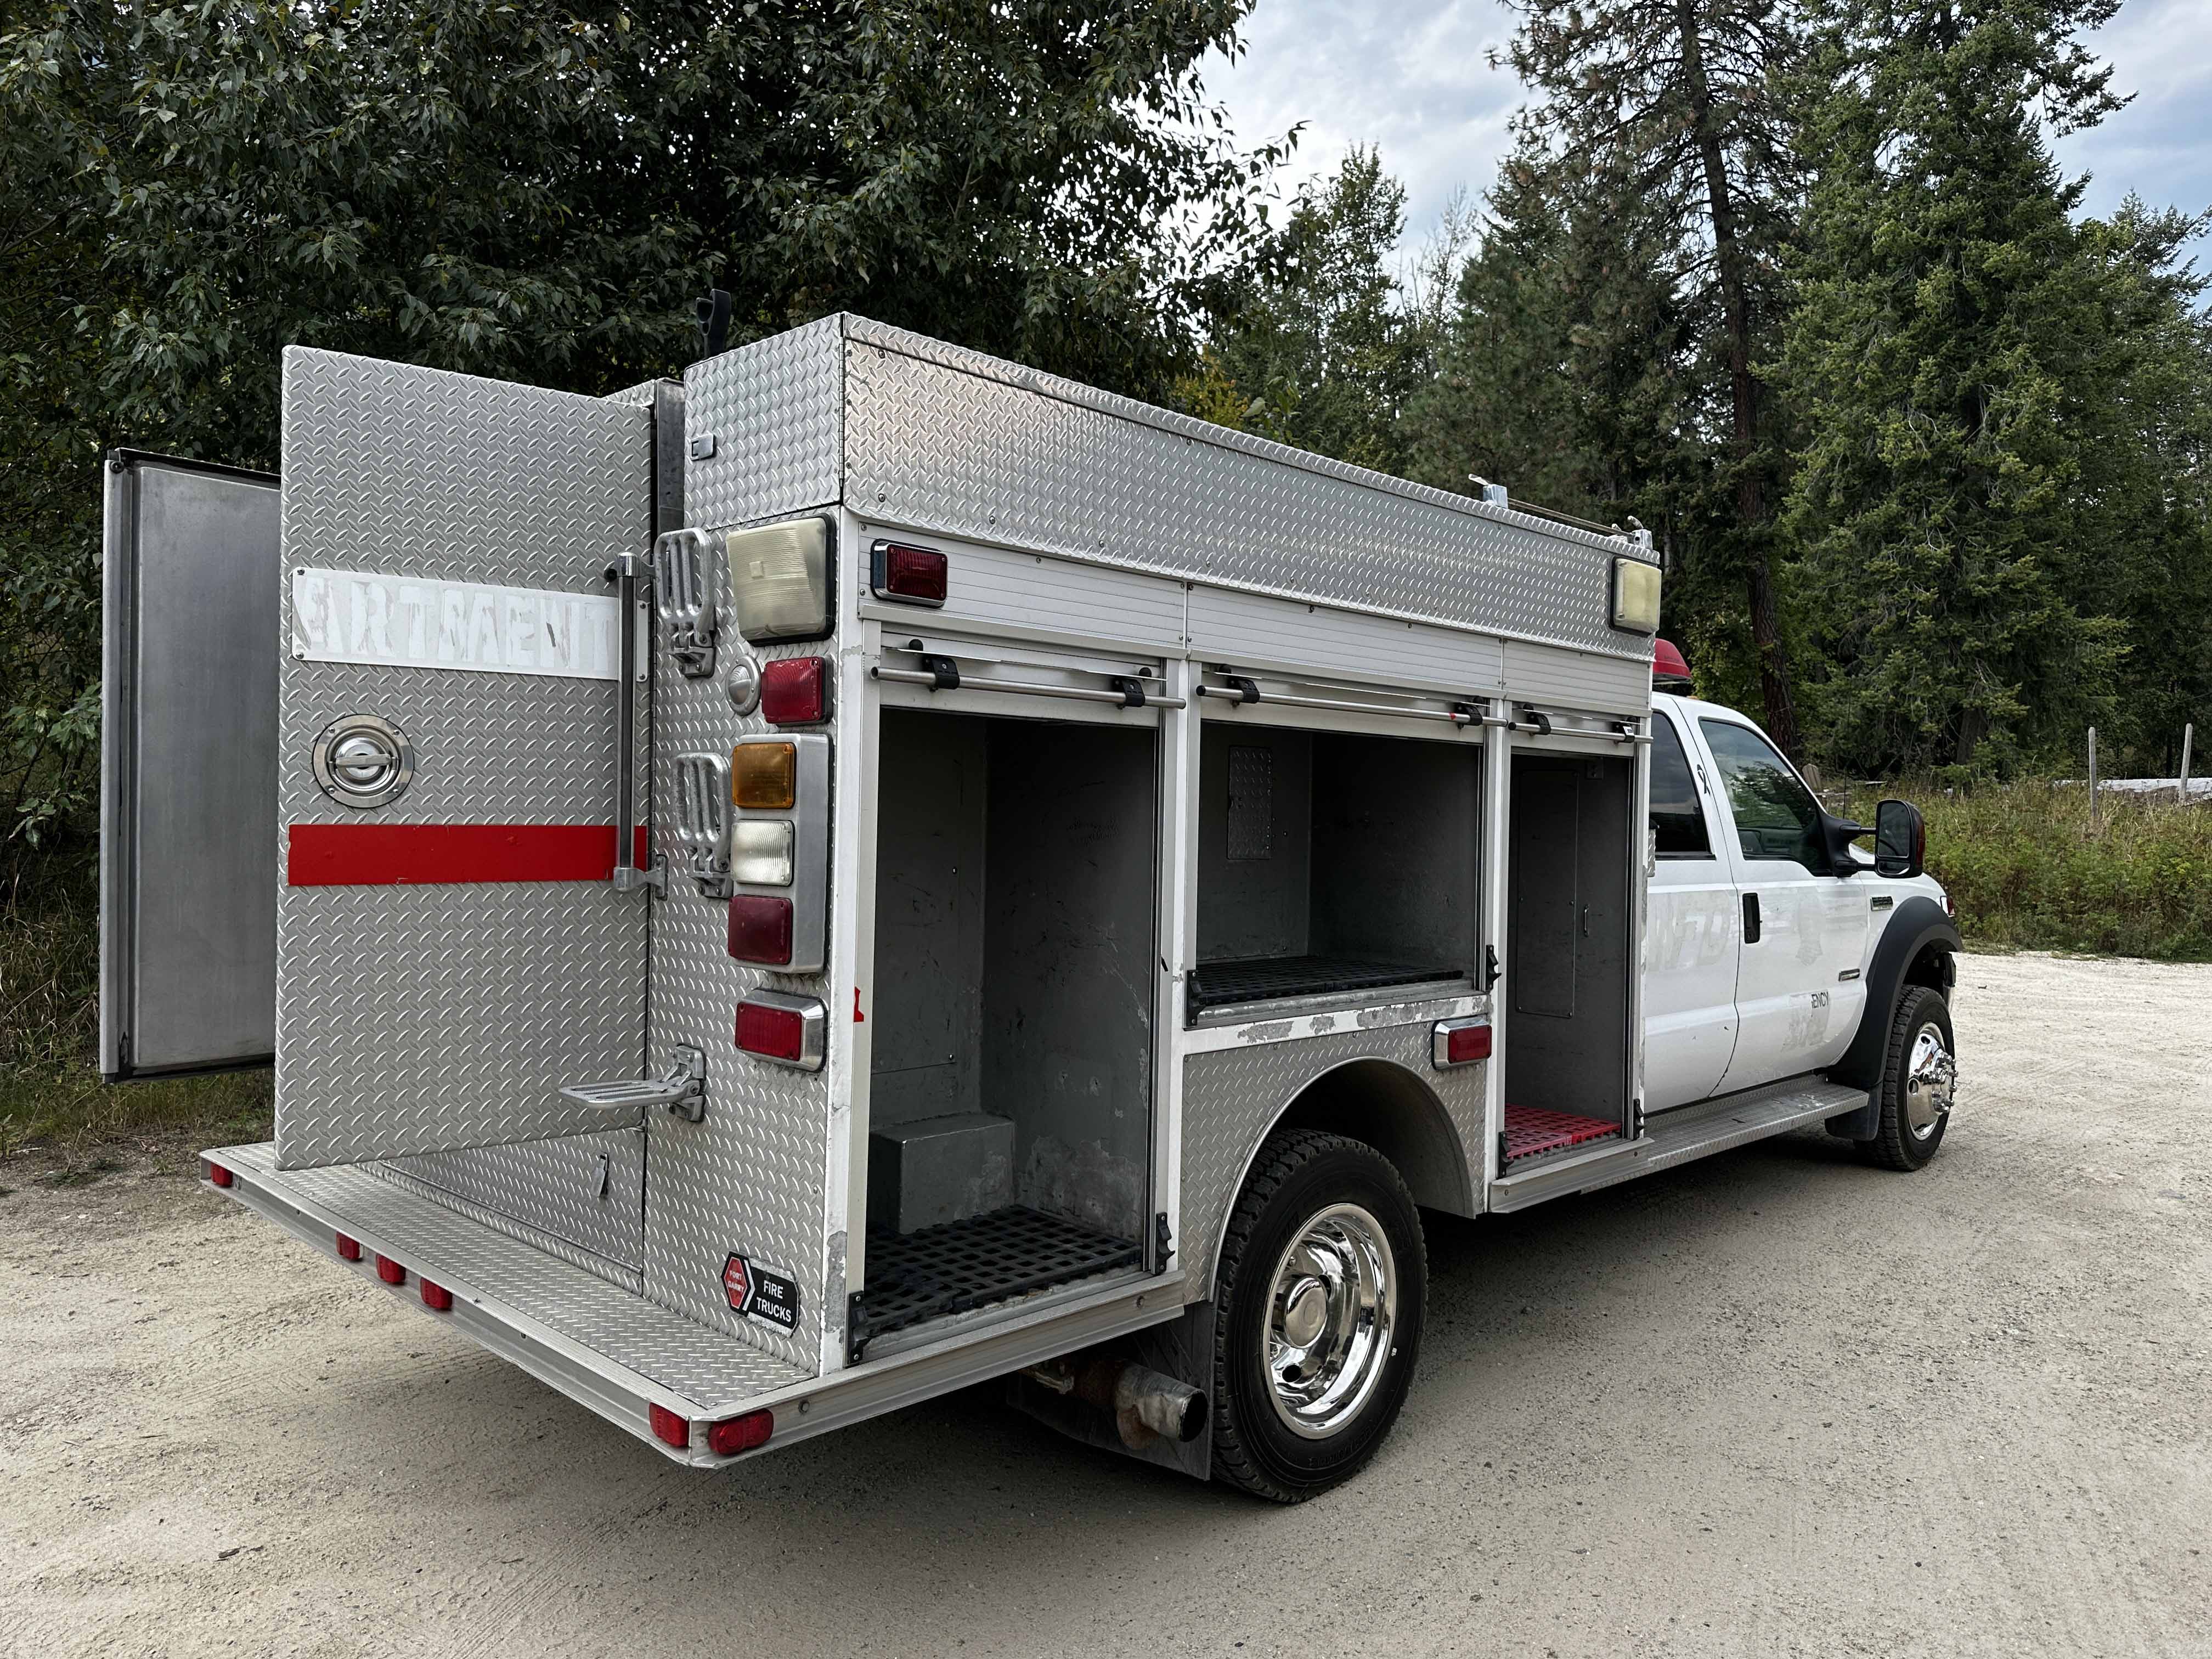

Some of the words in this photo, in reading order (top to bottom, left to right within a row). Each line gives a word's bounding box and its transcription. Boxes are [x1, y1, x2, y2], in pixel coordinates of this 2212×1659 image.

[729, 1271, 742, 1280] FORT
[728, 1280, 744, 1293] GARRY
[764, 1280, 783, 1299] FIRE
[757, 1296, 791, 1322] TRUCKS
